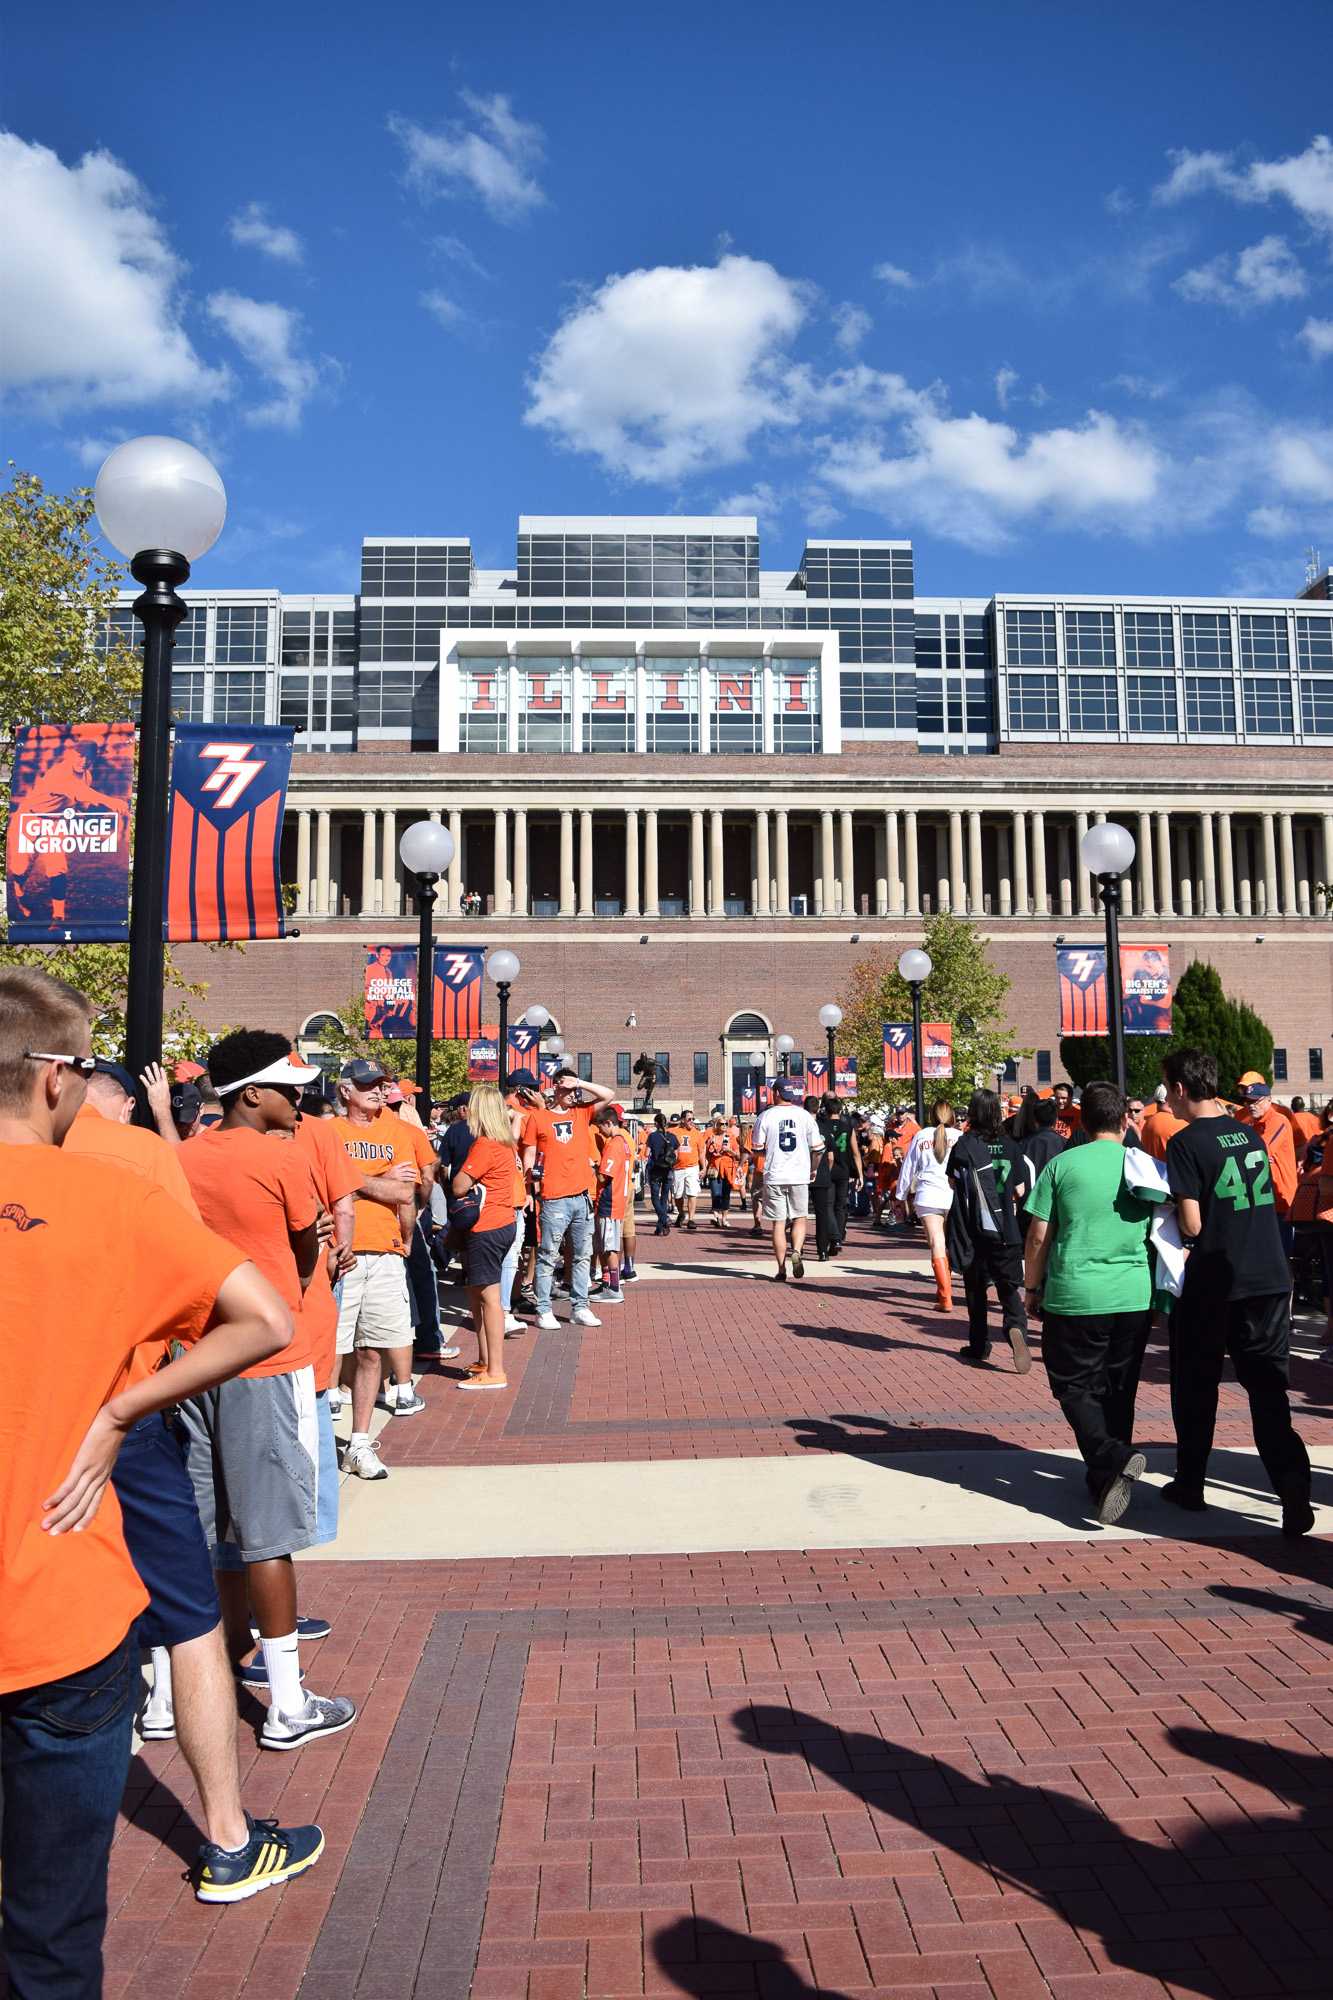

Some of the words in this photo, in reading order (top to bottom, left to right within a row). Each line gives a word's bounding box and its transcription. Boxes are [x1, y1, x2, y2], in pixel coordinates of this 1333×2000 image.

[471, 671, 808, 711] ILLINI
[198, 742, 266, 809] 77
[26, 818, 112, 836] GRANGE
[35, 836, 101, 853] GROVE
[444, 953, 473, 984] 77
[1068, 952, 1096, 982] 77
[369, 986, 414, 995] FOOTBALL
[371, 978, 413, 987] COLLEGE
[1125, 979, 1141, 988] BIG
[515, 1030, 532, 1049] 77
[889, 1027, 907, 1047] 77
[1216, 1131, 1249, 1149] NEMO
[1214, 1149, 1275, 1212] 42
